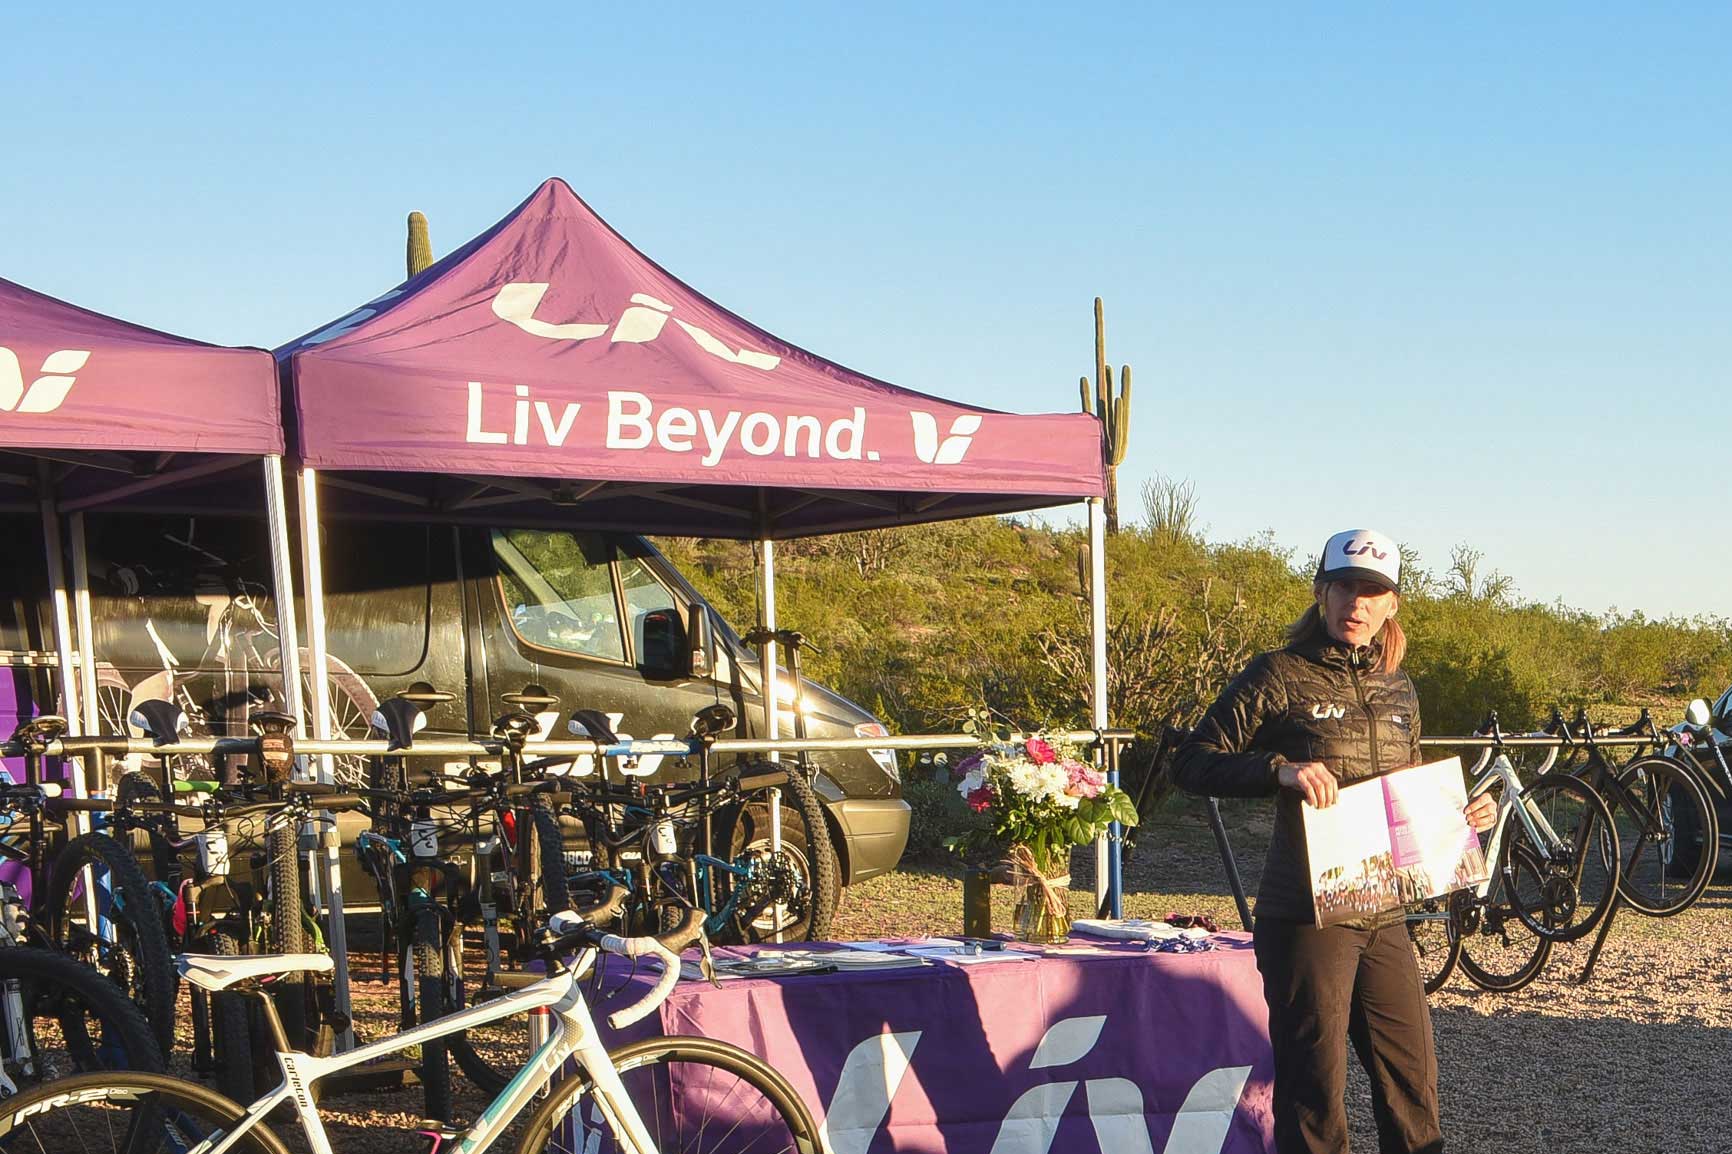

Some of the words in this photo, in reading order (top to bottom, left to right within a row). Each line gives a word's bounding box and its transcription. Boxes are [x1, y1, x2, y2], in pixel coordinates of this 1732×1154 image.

[491, 281, 781, 370] Liv
[465, 381, 581, 447] Liv
[605, 389, 880, 467] Beyond.
[1342, 539, 1387, 560] Liv
[1312, 703, 1346, 718] Liv
[14, 1088, 109, 1126] PR-2
